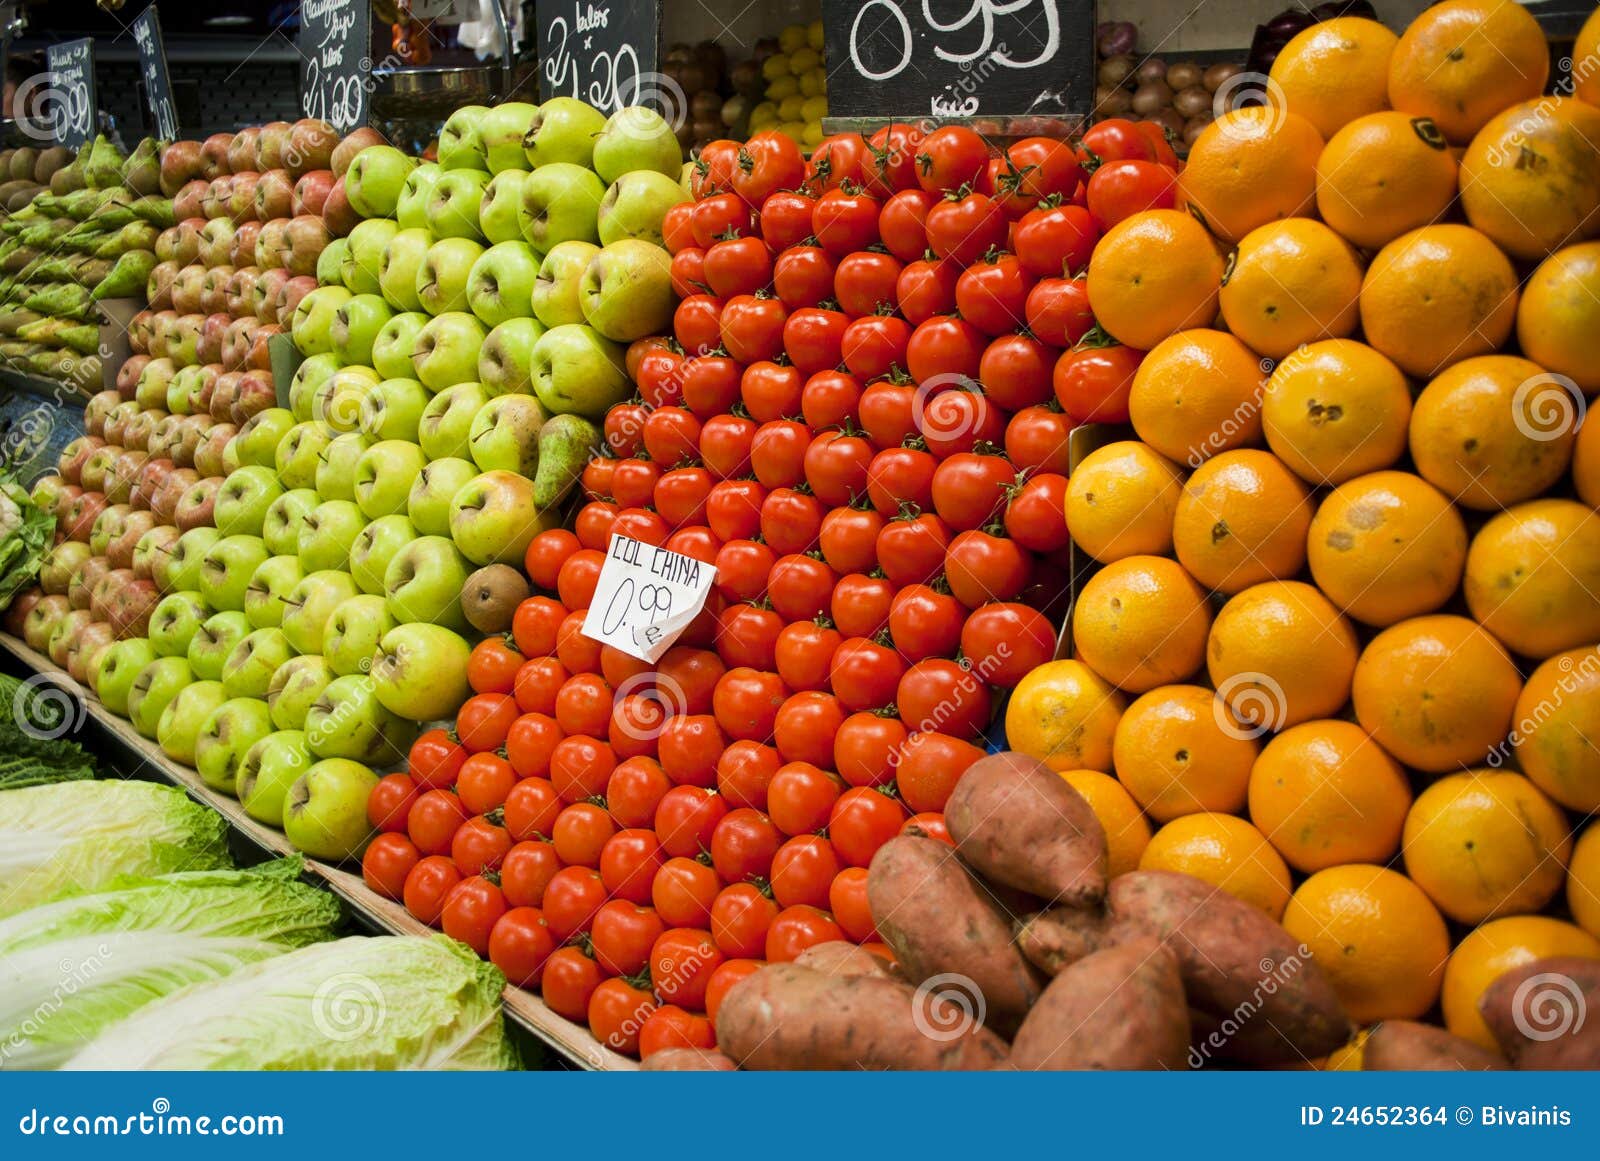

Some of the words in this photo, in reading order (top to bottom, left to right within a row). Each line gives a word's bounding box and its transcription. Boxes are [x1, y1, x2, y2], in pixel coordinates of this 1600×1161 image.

[612, 536, 642, 567] COL
[650, 548, 700, 589] CHINA
[602, 577, 673, 635] 0.99
